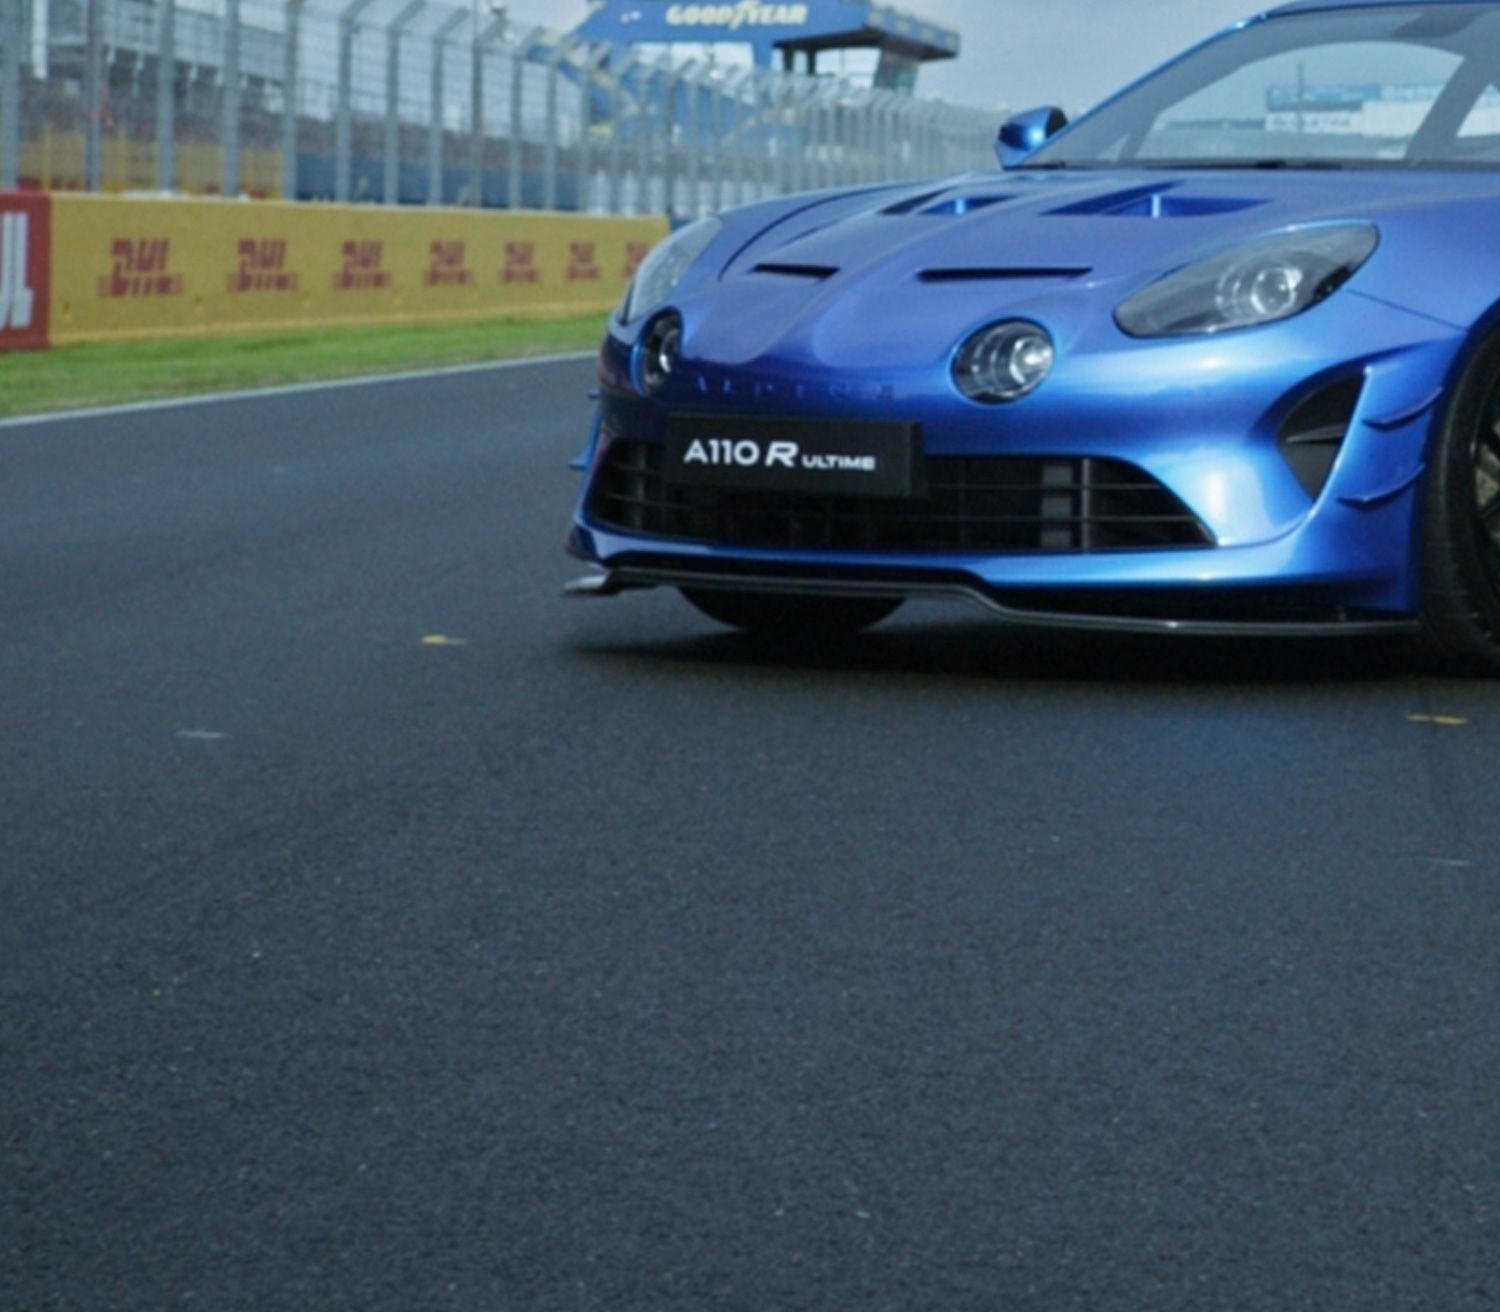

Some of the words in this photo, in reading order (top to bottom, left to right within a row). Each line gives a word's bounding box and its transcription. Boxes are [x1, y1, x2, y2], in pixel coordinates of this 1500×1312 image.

[683, 438, 760, 467] A110
[765, 441, 799, 468] R
[801, 454, 877, 471] ULTIME
